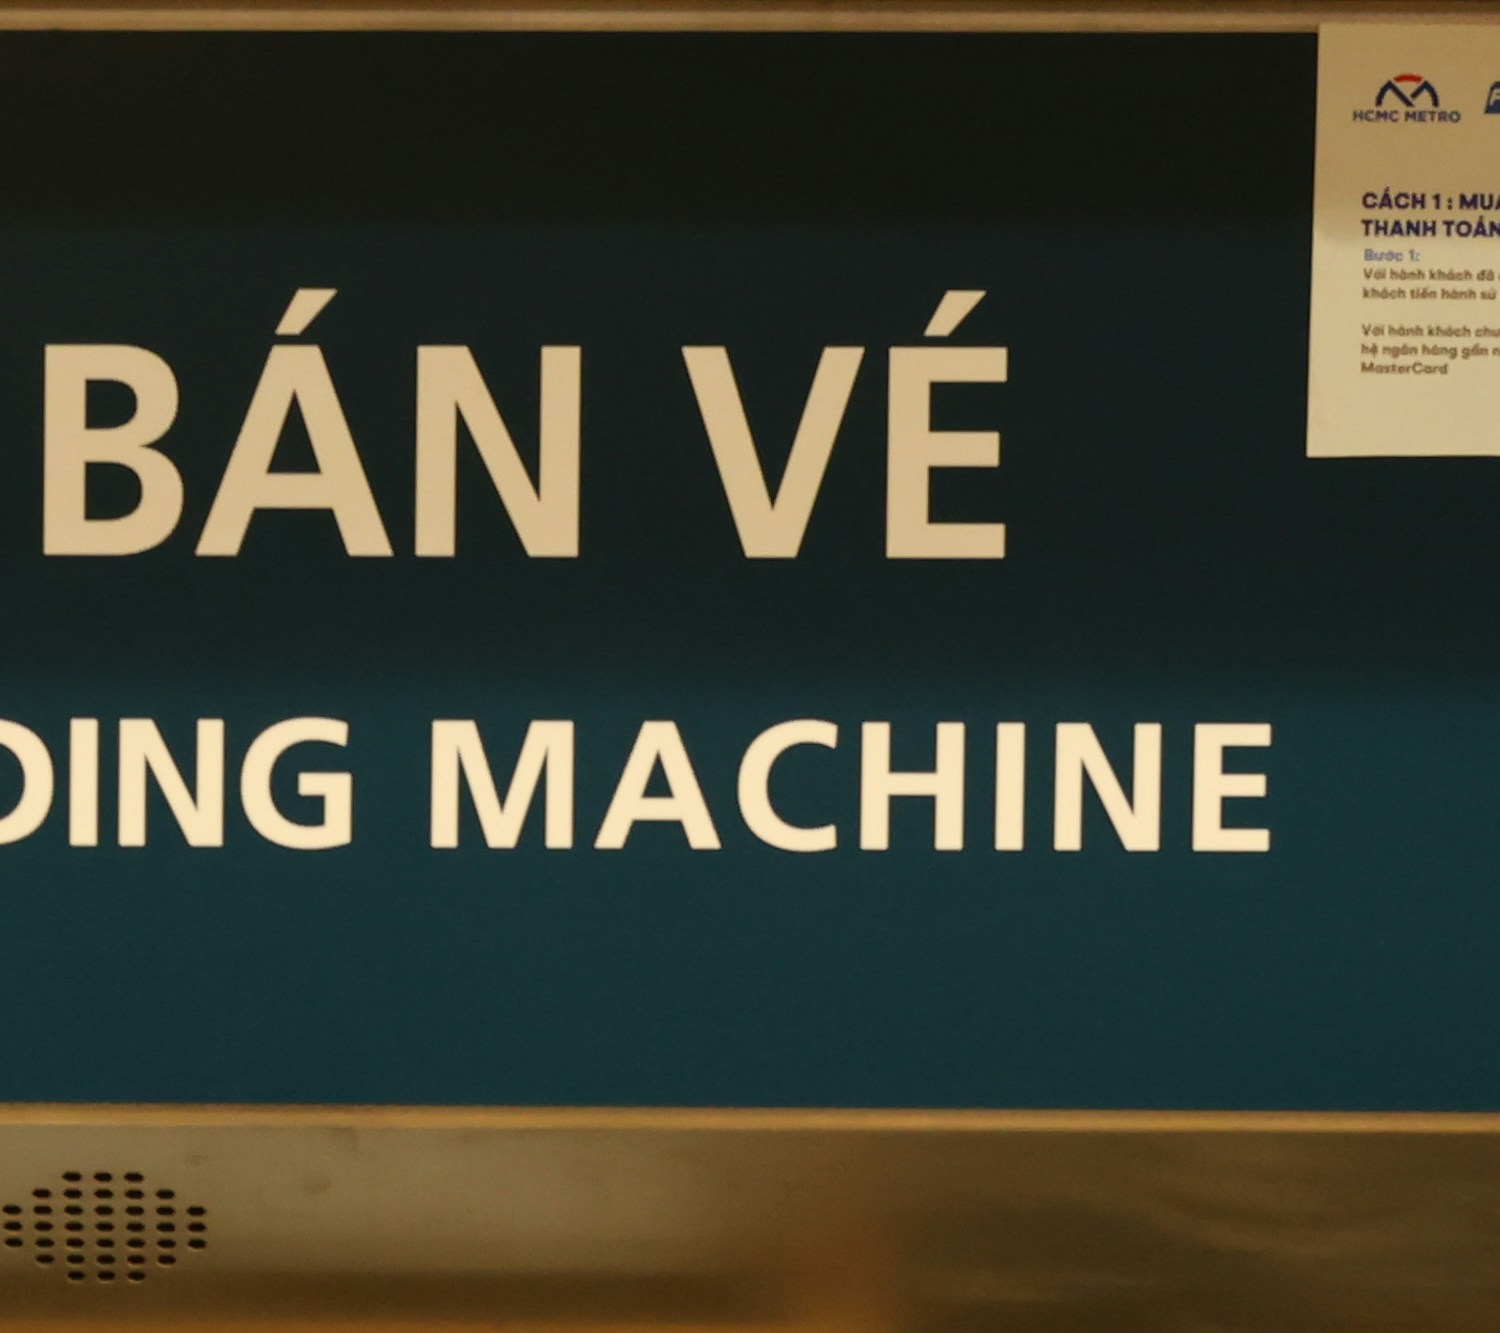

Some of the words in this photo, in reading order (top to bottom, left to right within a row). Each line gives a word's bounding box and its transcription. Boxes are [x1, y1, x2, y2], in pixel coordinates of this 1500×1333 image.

[1352, 106, 1399, 123] HCMC
[1404, 106, 1461, 123] METRO
[1362, 186, 1426, 210] CÁCH
[1432, 193, 1441, 210] 1
[1360, 218, 1437, 237] THANH
[43, 288, 581, 558] BÁN
[681, 290, 1008, 559] VÉ
[431, 719, 1271, 852] MACHINE
